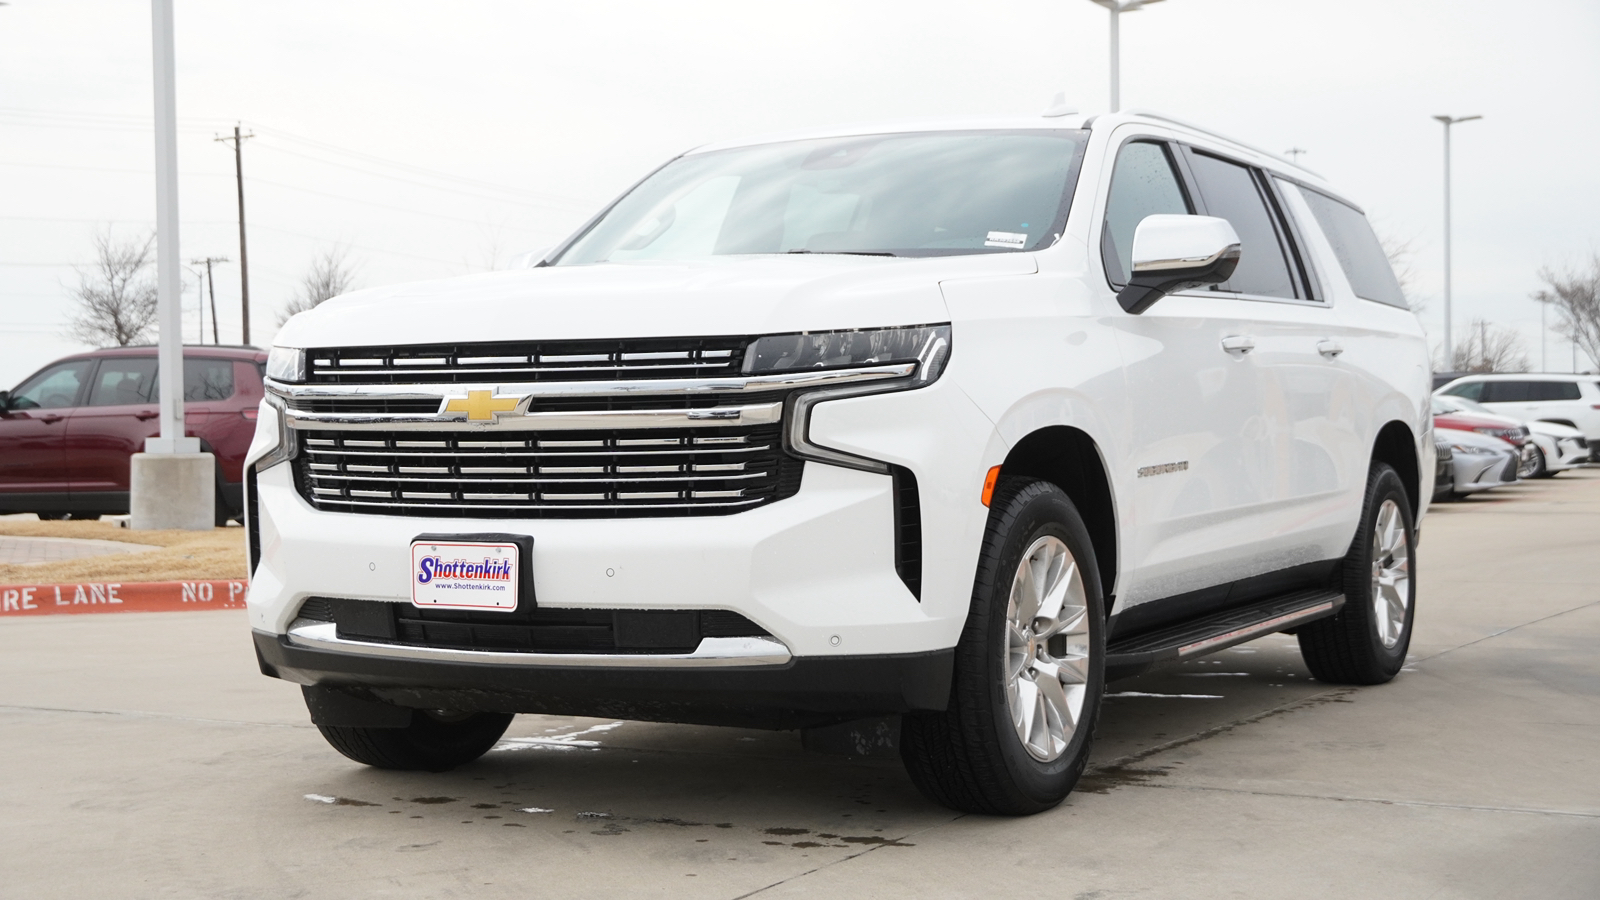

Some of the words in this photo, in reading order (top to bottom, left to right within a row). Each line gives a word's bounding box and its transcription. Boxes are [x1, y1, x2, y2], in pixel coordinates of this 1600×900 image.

[418, 557, 511, 583] Shottenkirk
[0, 587, 38, 611] RE
[55, 583, 123, 605] LANE
[182, 582, 213, 602] NO
[435, 583, 506, 591] www.Shottenkirk.com
